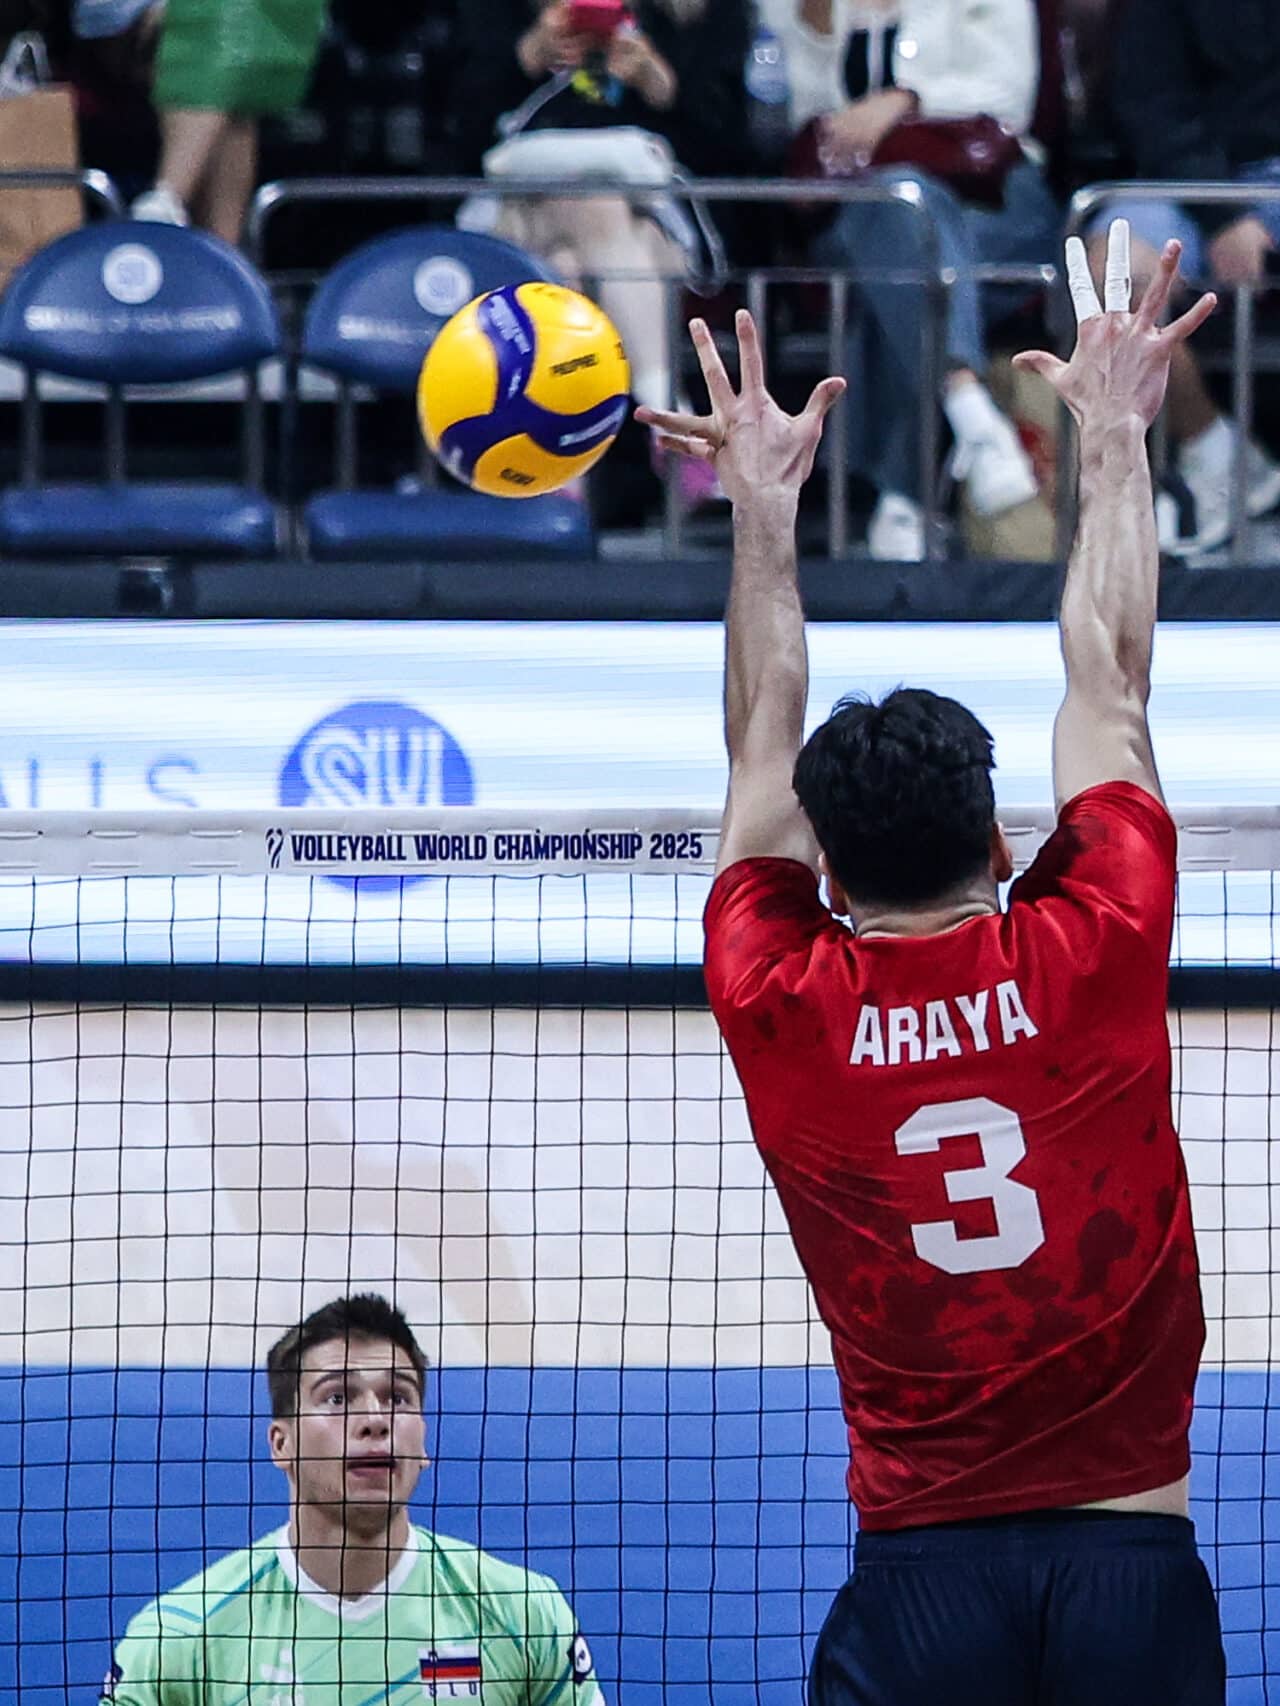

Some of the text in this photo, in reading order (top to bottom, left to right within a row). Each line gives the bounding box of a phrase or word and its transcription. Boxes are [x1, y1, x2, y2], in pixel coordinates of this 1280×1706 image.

[290, 832, 703, 862] VOLLEYBALL WORLD CHAMPIONSHIP 2025
[849, 979, 1039, 1066] ARAYA
[894, 1096, 1046, 1275] 3
